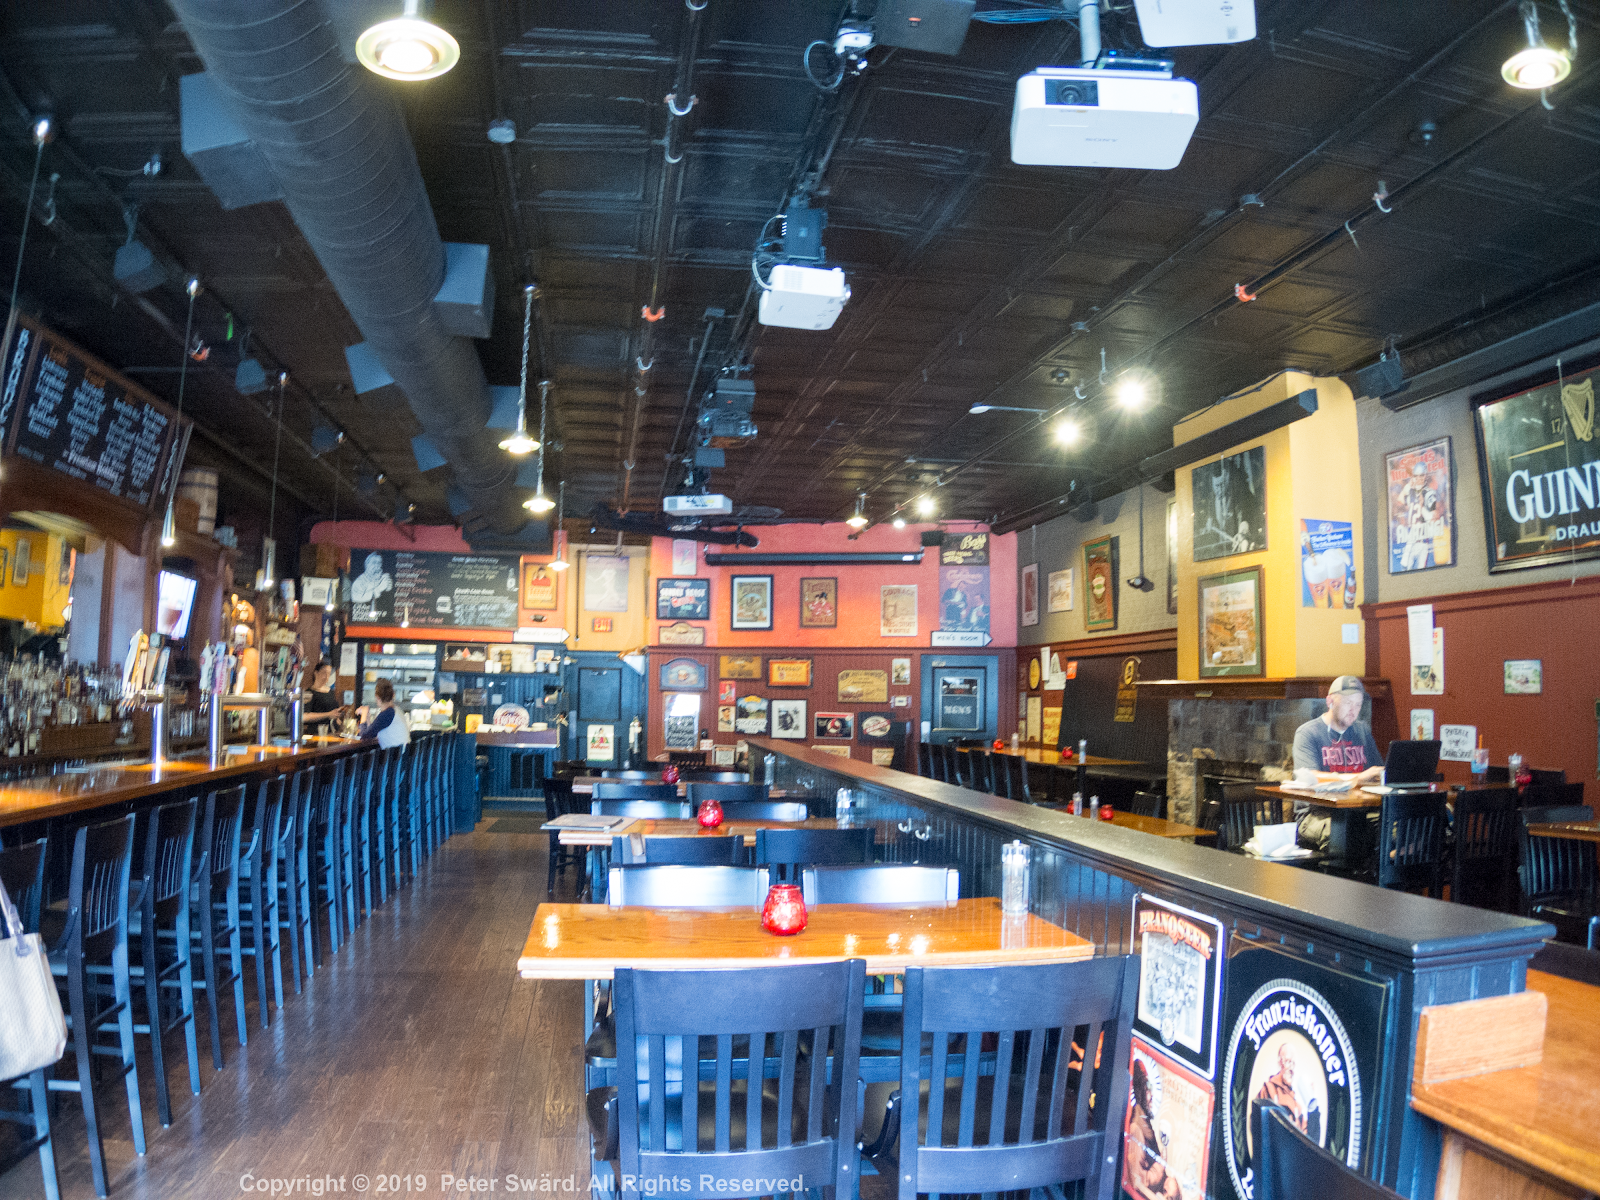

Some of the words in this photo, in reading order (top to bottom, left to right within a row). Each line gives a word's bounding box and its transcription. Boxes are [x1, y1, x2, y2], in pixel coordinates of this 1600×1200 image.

[1505, 460, 1600, 524] GUIN
[1322, 746, 1344, 766] RED
[1344, 745, 1367, 766] SOX
[1246, 996, 1345, 1087] Franziskaner
